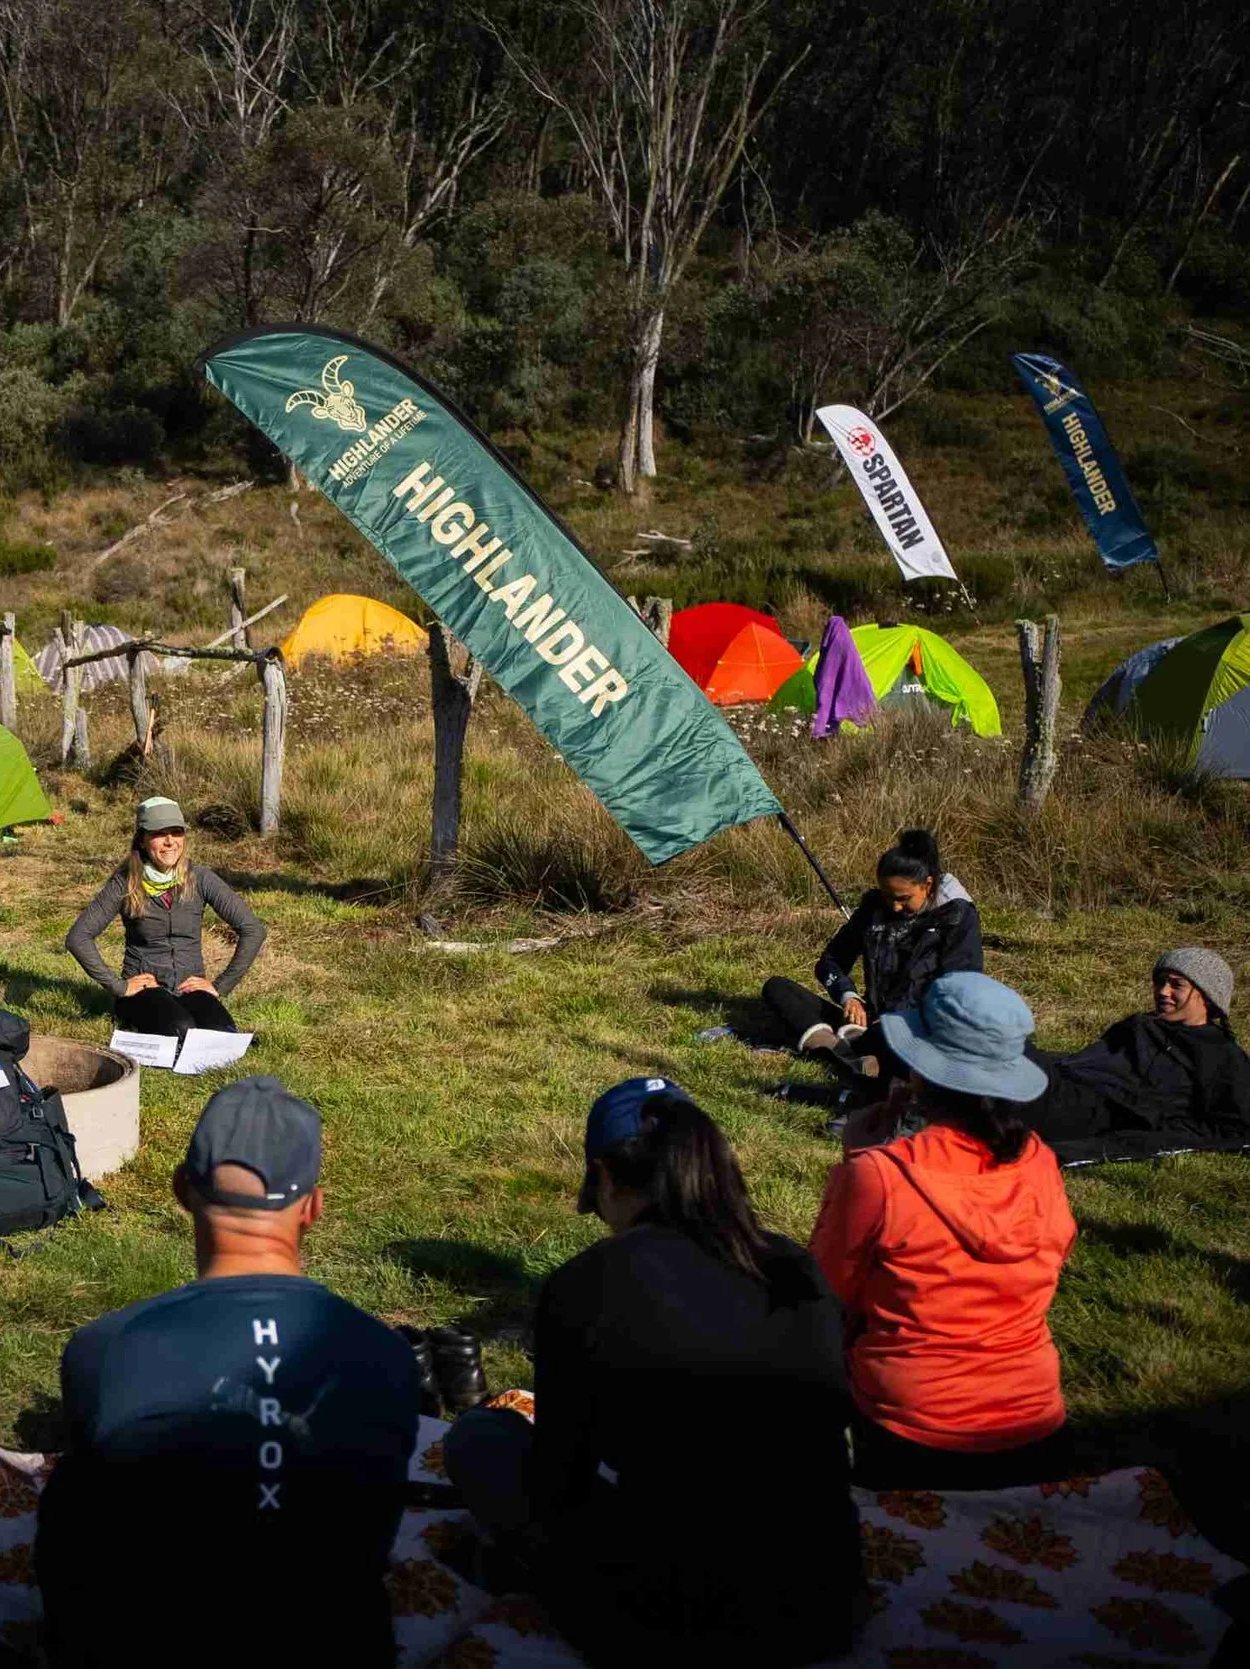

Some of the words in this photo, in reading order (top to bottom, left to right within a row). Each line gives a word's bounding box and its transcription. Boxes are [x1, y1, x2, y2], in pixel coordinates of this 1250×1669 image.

[328, 398, 418, 480] HIGHLANDER
[342, 449, 383, 488] ADVENTURE
[380, 442, 391, 453] OF
[395, 409, 428, 440] LIFETIME
[1062, 412, 1116, 515] HIGHLANDER
[863, 453, 925, 550] SPARTAN
[392, 461, 630, 718] HIGHLANDER
[252, 1318, 282, 1510] HYROX
